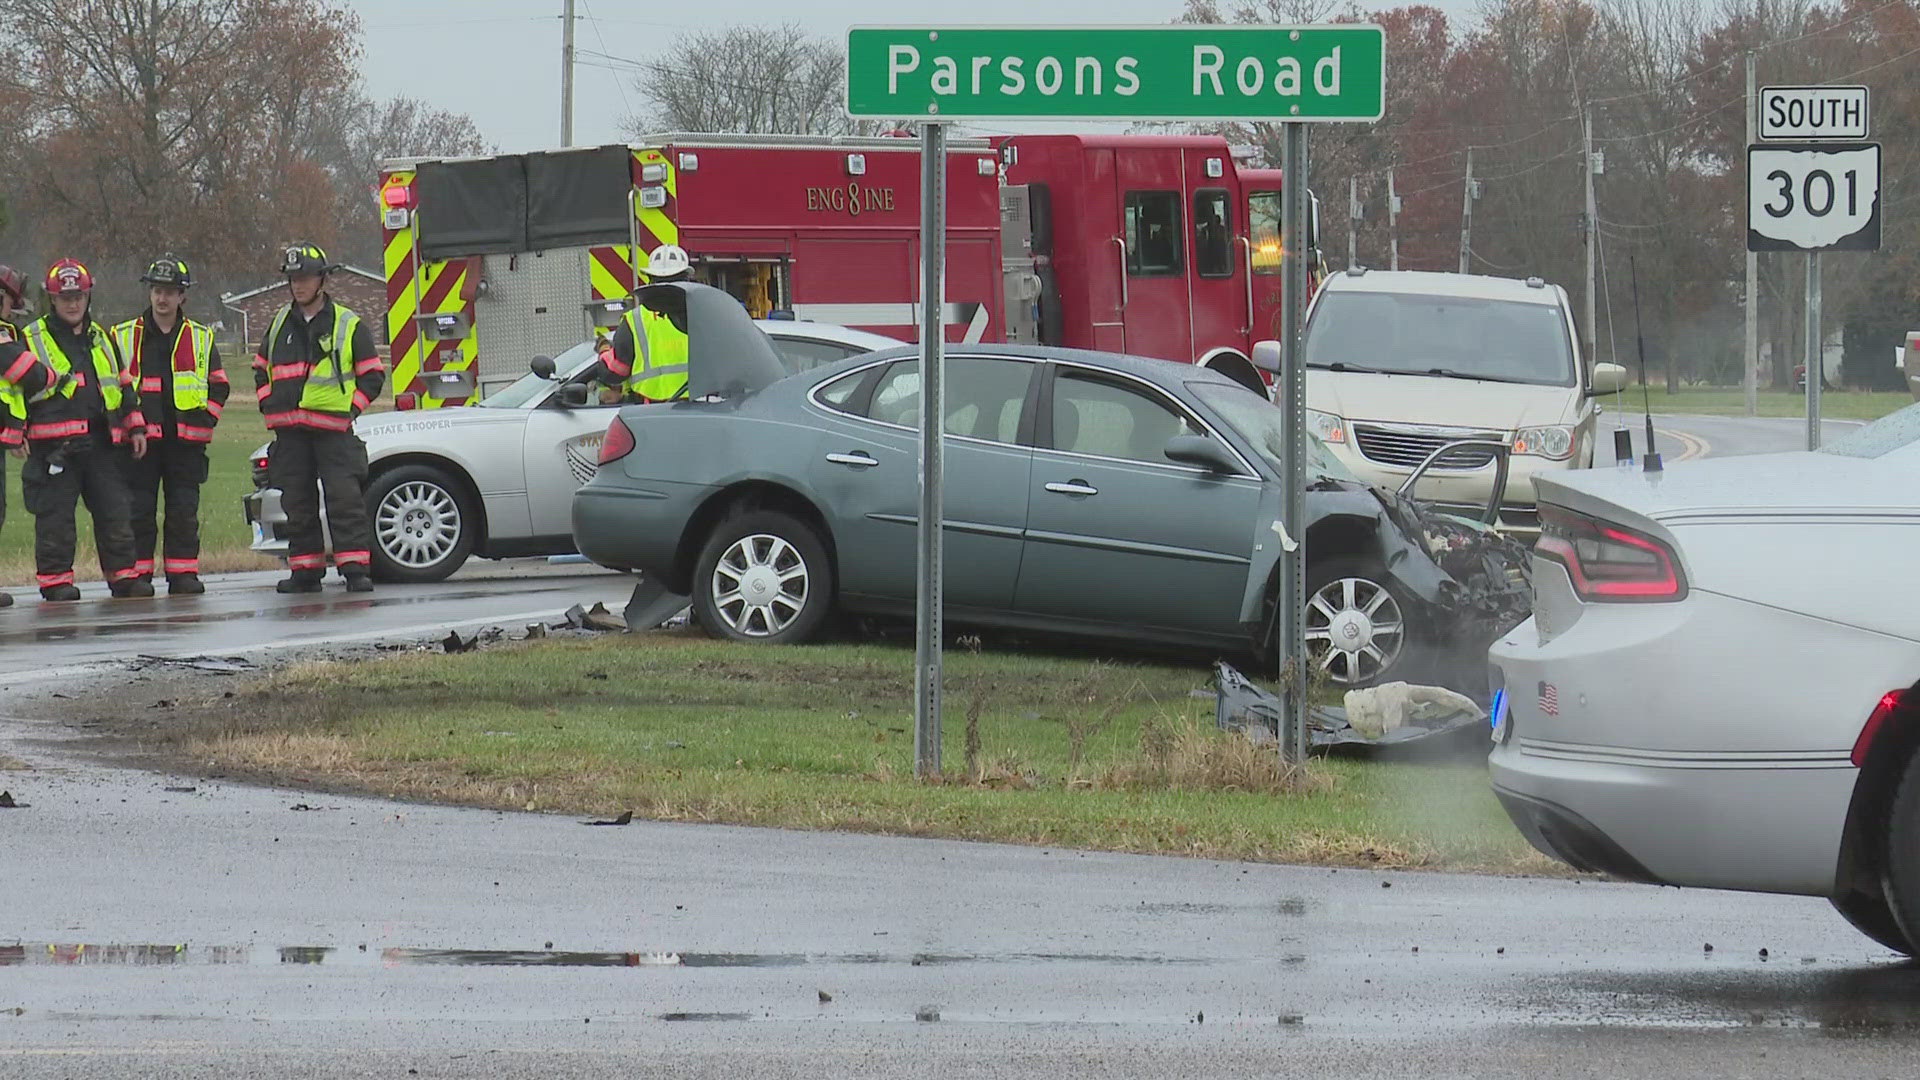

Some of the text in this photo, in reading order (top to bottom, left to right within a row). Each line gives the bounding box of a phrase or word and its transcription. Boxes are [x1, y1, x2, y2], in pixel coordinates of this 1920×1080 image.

[888, 44, 1341, 96] Parsons Road
[1768, 95, 1860, 128] SOUTH
[1764, 169, 1857, 218] 301
[157, 265, 172, 276] 32
[372, 419, 451, 436] STATE TROOPER
